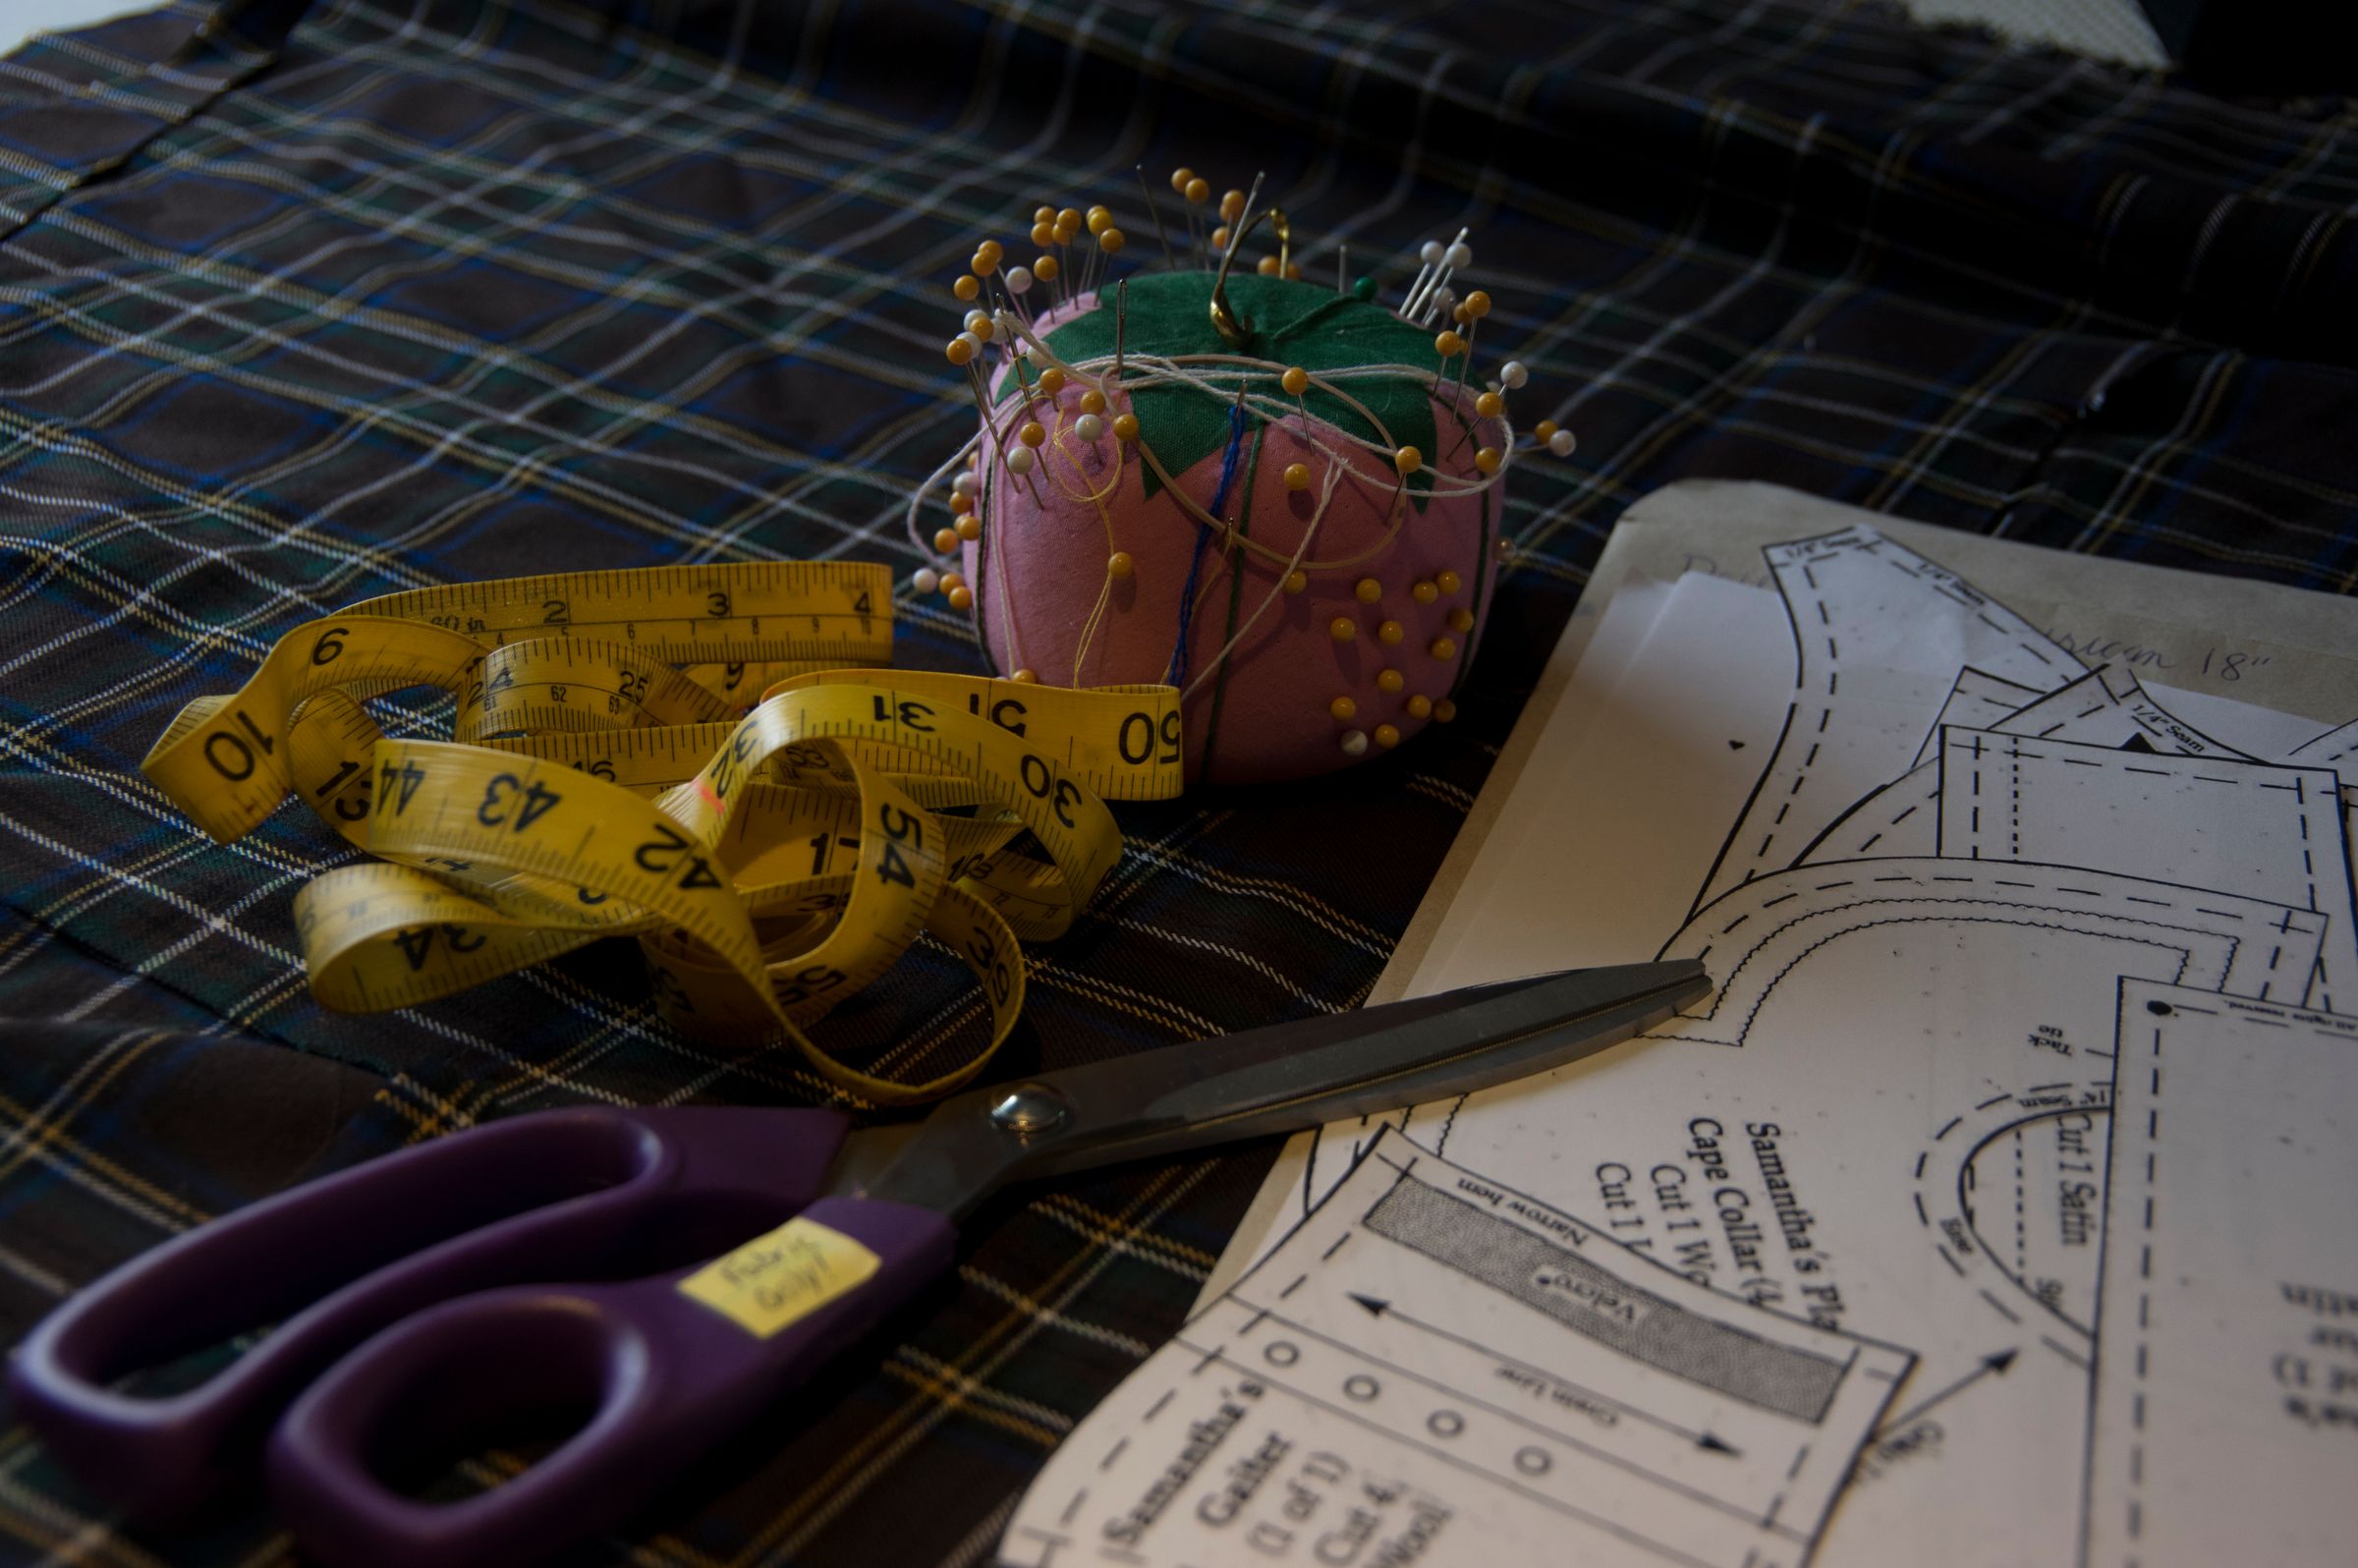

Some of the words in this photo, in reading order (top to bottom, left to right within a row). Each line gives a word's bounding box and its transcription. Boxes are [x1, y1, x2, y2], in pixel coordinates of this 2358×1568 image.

[542, 599, 568, 625] 2
[707, 591, 730, 617] 3
[854, 590, 871, 614] 4
[627, 623, 636, 640] 6
[751, 615, 760, 636] 8
[812, 616, 821, 634] 9
[549, 685, 568, 703] 62
[608, 694, 622, 716] 63
[618, 669, 649, 704] 25
[871, 695, 936, 733] 31
[1118, 709, 1181, 766] 50
[2164, 723, 2206, 754] Seam
[203, 709, 274, 782] 10
[570, 759, 617, 784] 6
[1020, 754, 1084, 830] 30
[376, 757, 426, 817] 44
[477, 772, 562, 833] 43
[634, 822, 723, 890] 42
[877, 801, 924, 891] 54
[2028, 1035, 2073, 1058] Tack
[2056, 1111, 2093, 1159] Cut
[1457, 1176, 1504, 1208] hem
[1595, 1161, 1632, 1215] Cut
[1650, 1162, 1687, 1216] Cut
[1688, 1116, 1728, 1181] Cape
[1712, 1185, 1768, 1274] Collar
[1745, 1121, 1829, 1275] Samantha's
[2059, 1181, 2098, 1248] Satin
[1505, 1200, 1590, 1249] Narrow
[1100, 1375, 1266, 1548] Samantha's
[1194, 1428, 1295, 1529] Gaiter
